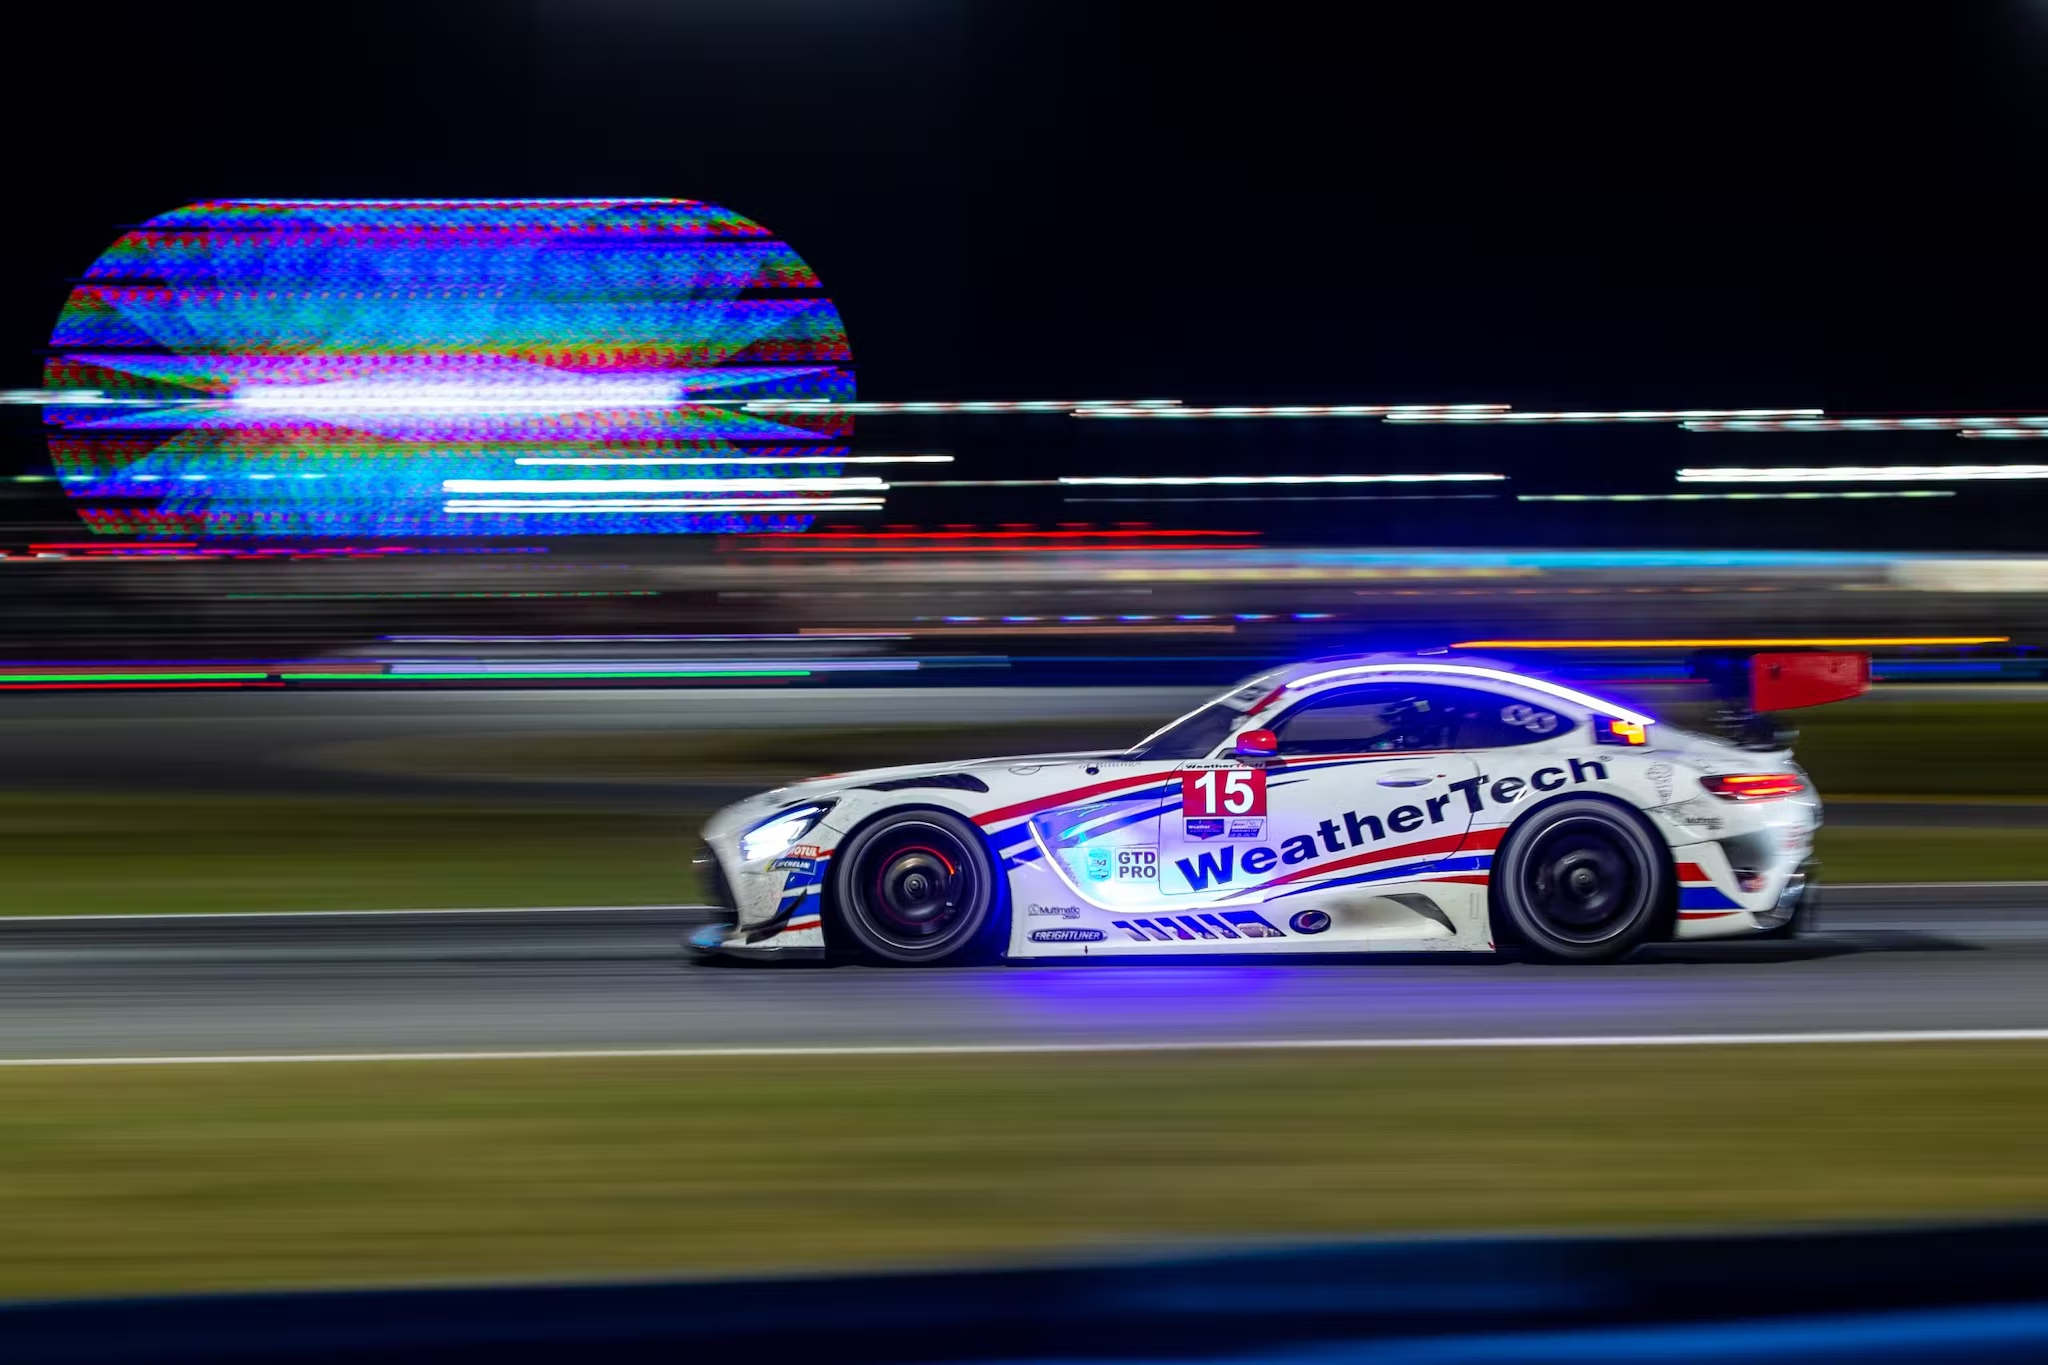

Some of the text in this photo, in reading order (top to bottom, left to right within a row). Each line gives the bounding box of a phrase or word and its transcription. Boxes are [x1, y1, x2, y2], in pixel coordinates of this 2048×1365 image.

[1195, 771, 1254, 814] 15
[1174, 758, 1610, 892] WeatherTech
[1118, 851, 1156, 865] GTD
[1119, 866, 1157, 879] PRO
[1034, 931, 1101, 941] FREIGHTLINER
